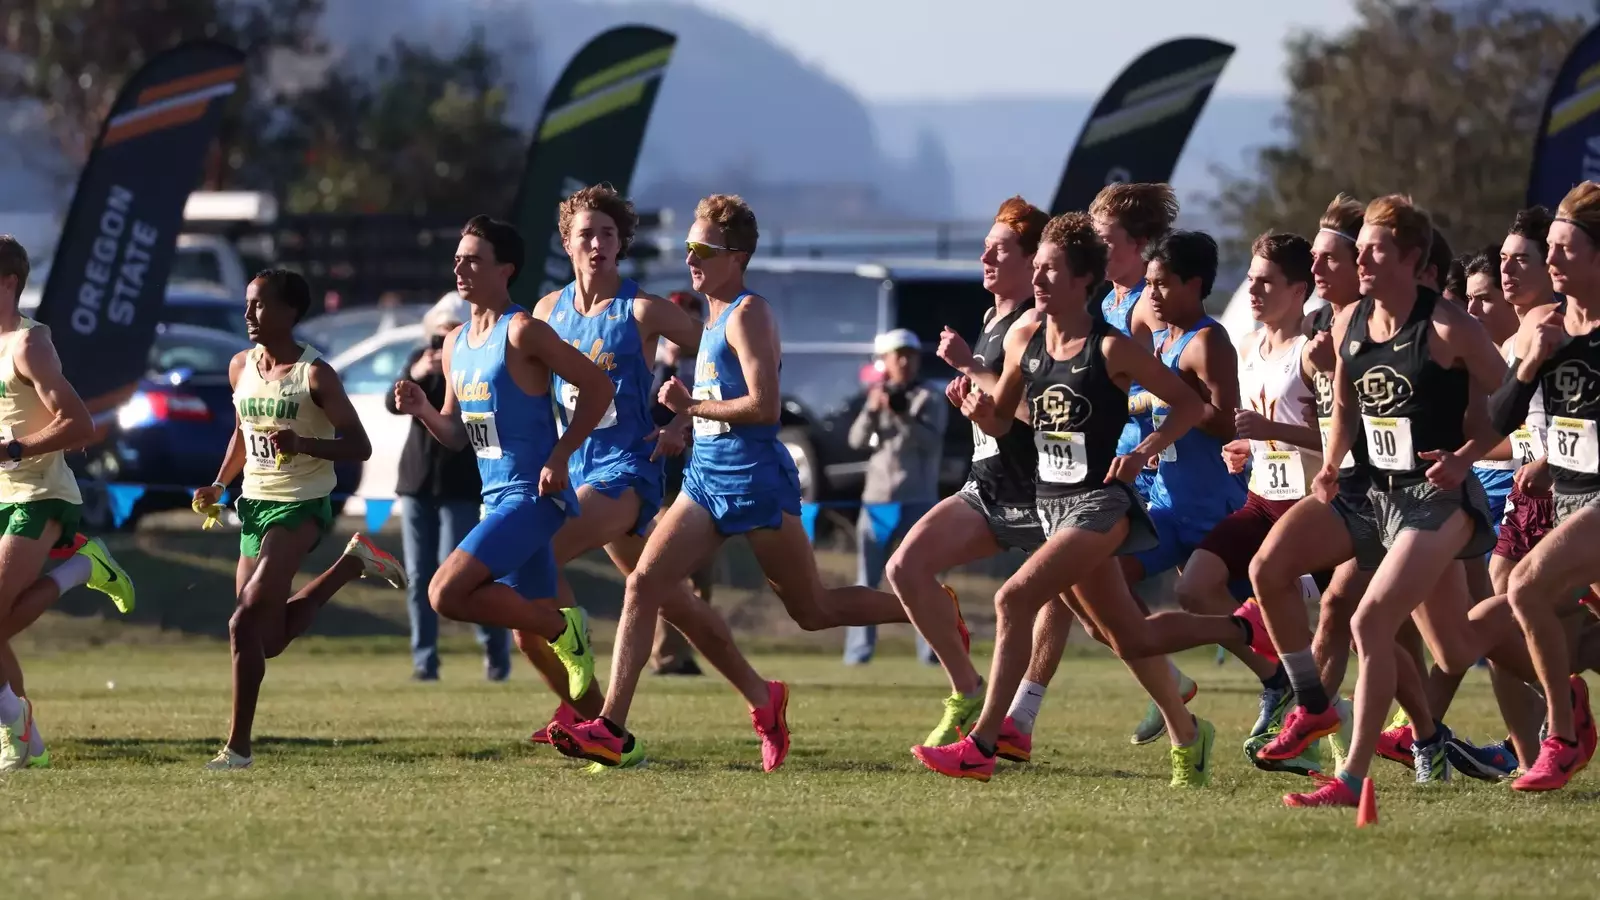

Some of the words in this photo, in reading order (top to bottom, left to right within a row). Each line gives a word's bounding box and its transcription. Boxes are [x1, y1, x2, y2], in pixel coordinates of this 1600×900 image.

[71, 184, 133, 335] OREGON
[108, 219, 157, 326] STATE
[1363, 373, 1394, 404] CU
[240, 398, 299, 420] OREGON
[1043, 391, 1071, 423] CU
[467, 422, 490, 447] 247
[1373, 430, 1397, 457] 90
[1557, 430, 1580, 457] 87
[1044, 444, 1075, 469] 101
[1268, 462, 1289, 488] 31
